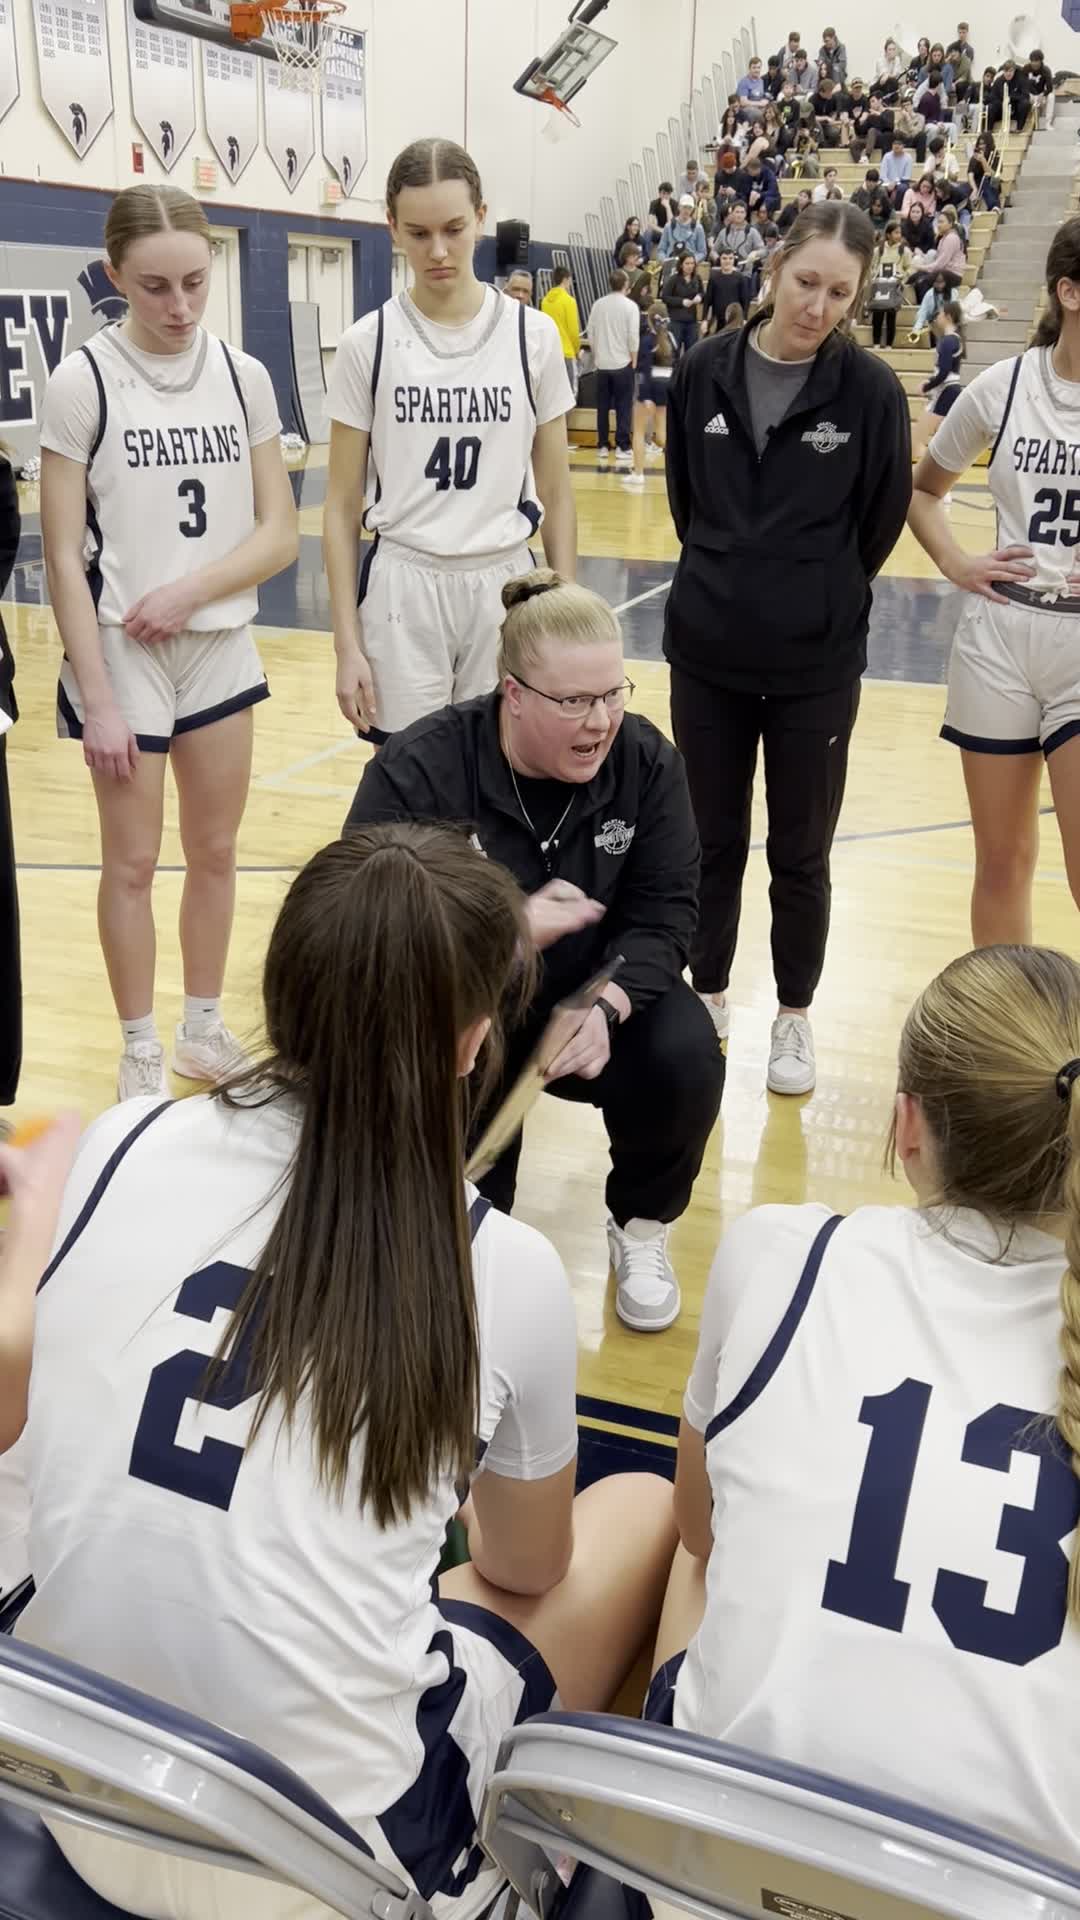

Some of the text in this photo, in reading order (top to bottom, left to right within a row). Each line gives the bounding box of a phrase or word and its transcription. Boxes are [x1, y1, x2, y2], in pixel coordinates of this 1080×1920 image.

[394, 386, 512, 423] SPARTANS
[704, 425, 730, 435] adidas
[124, 424, 241, 468] SPARTANS
[424, 436, 482, 491] 40
[1013, 437, 1080, 476] SPART
[177, 479, 208, 538] 3
[1028, 487, 1080, 547] 25
[129, 1260, 275, 1512] 2
[821, 1377, 1080, 1667] 13
